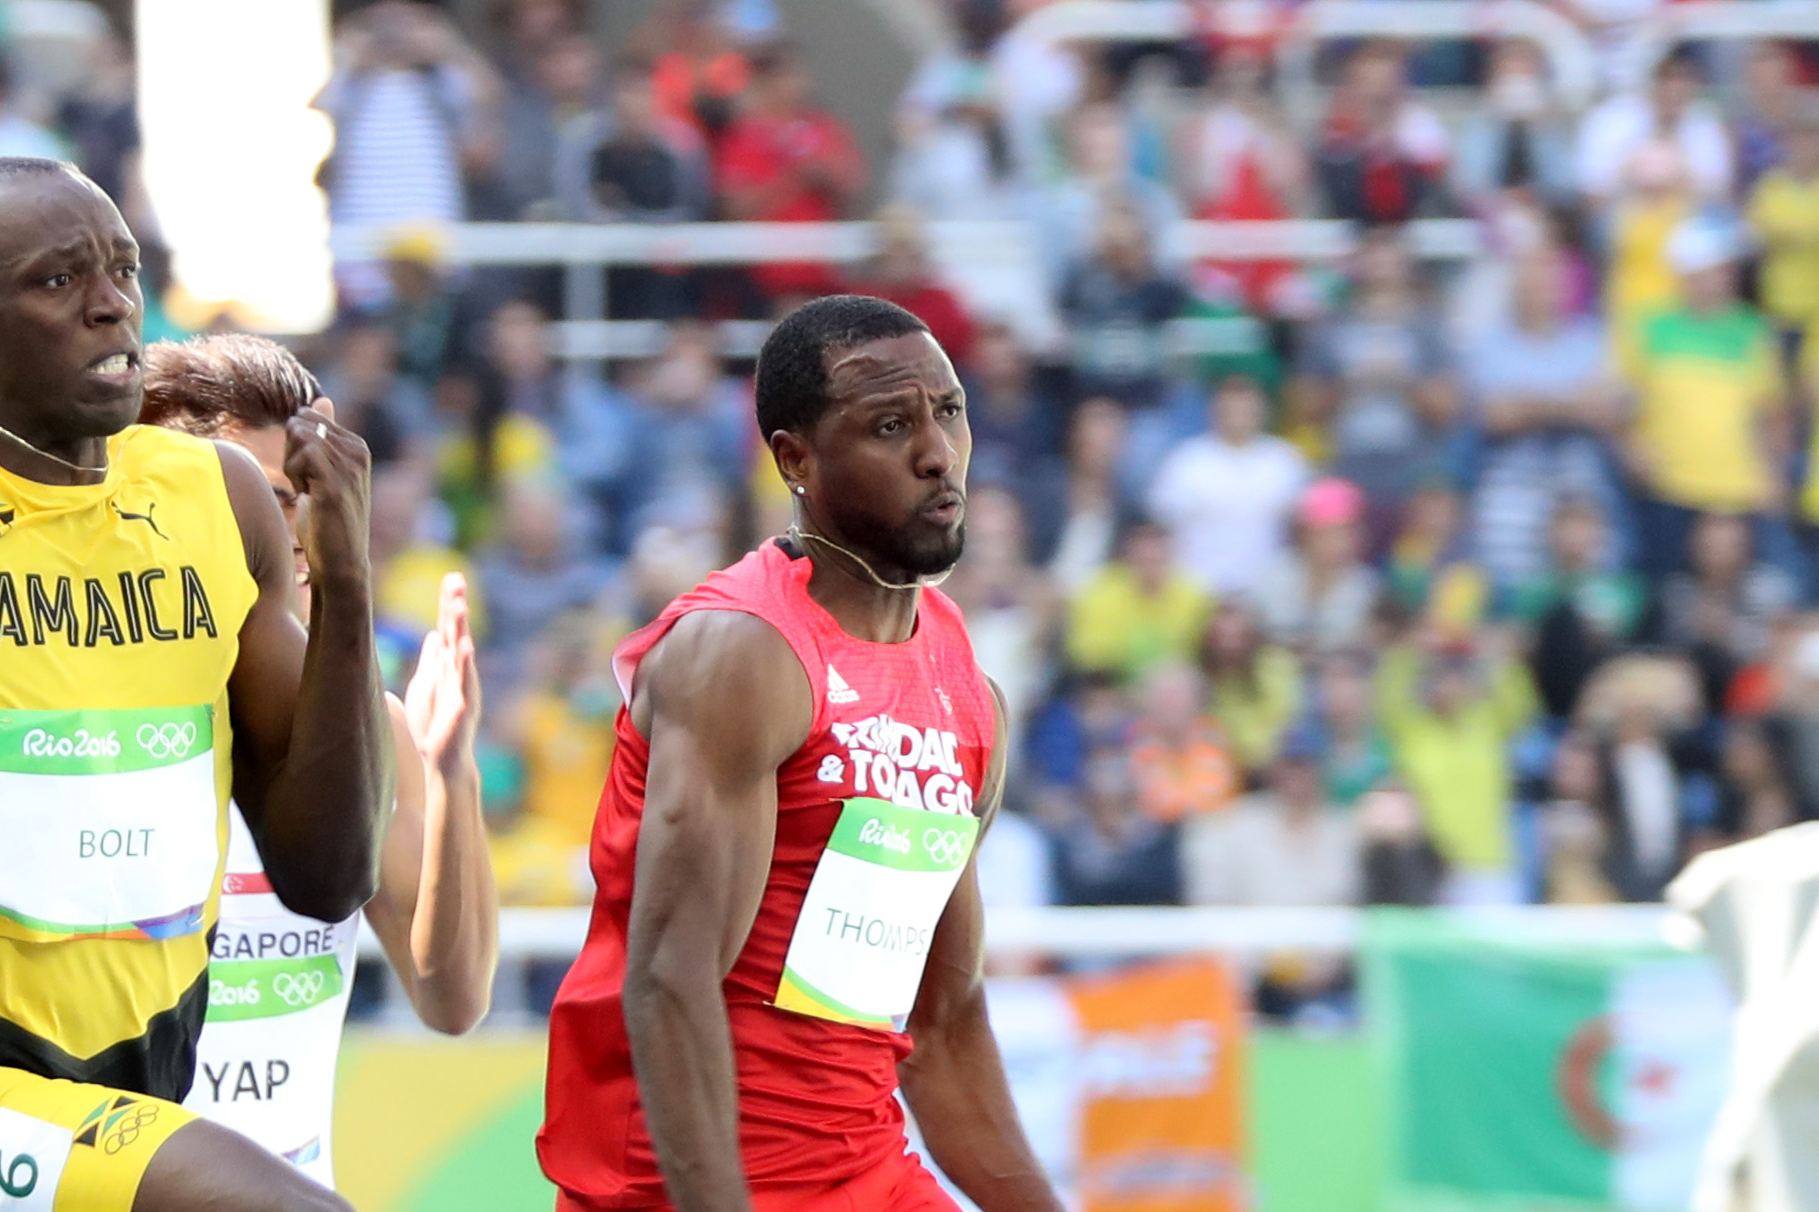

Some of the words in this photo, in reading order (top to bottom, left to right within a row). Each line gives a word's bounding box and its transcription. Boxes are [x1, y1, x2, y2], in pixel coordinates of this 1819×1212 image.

[817, 754, 845, 784] &
[849, 750, 975, 818] TOAGO
[78, 828, 156, 859] BOLT
[211, 924, 334, 959] GAPORE
[201, 1060, 291, 1103] YAP
